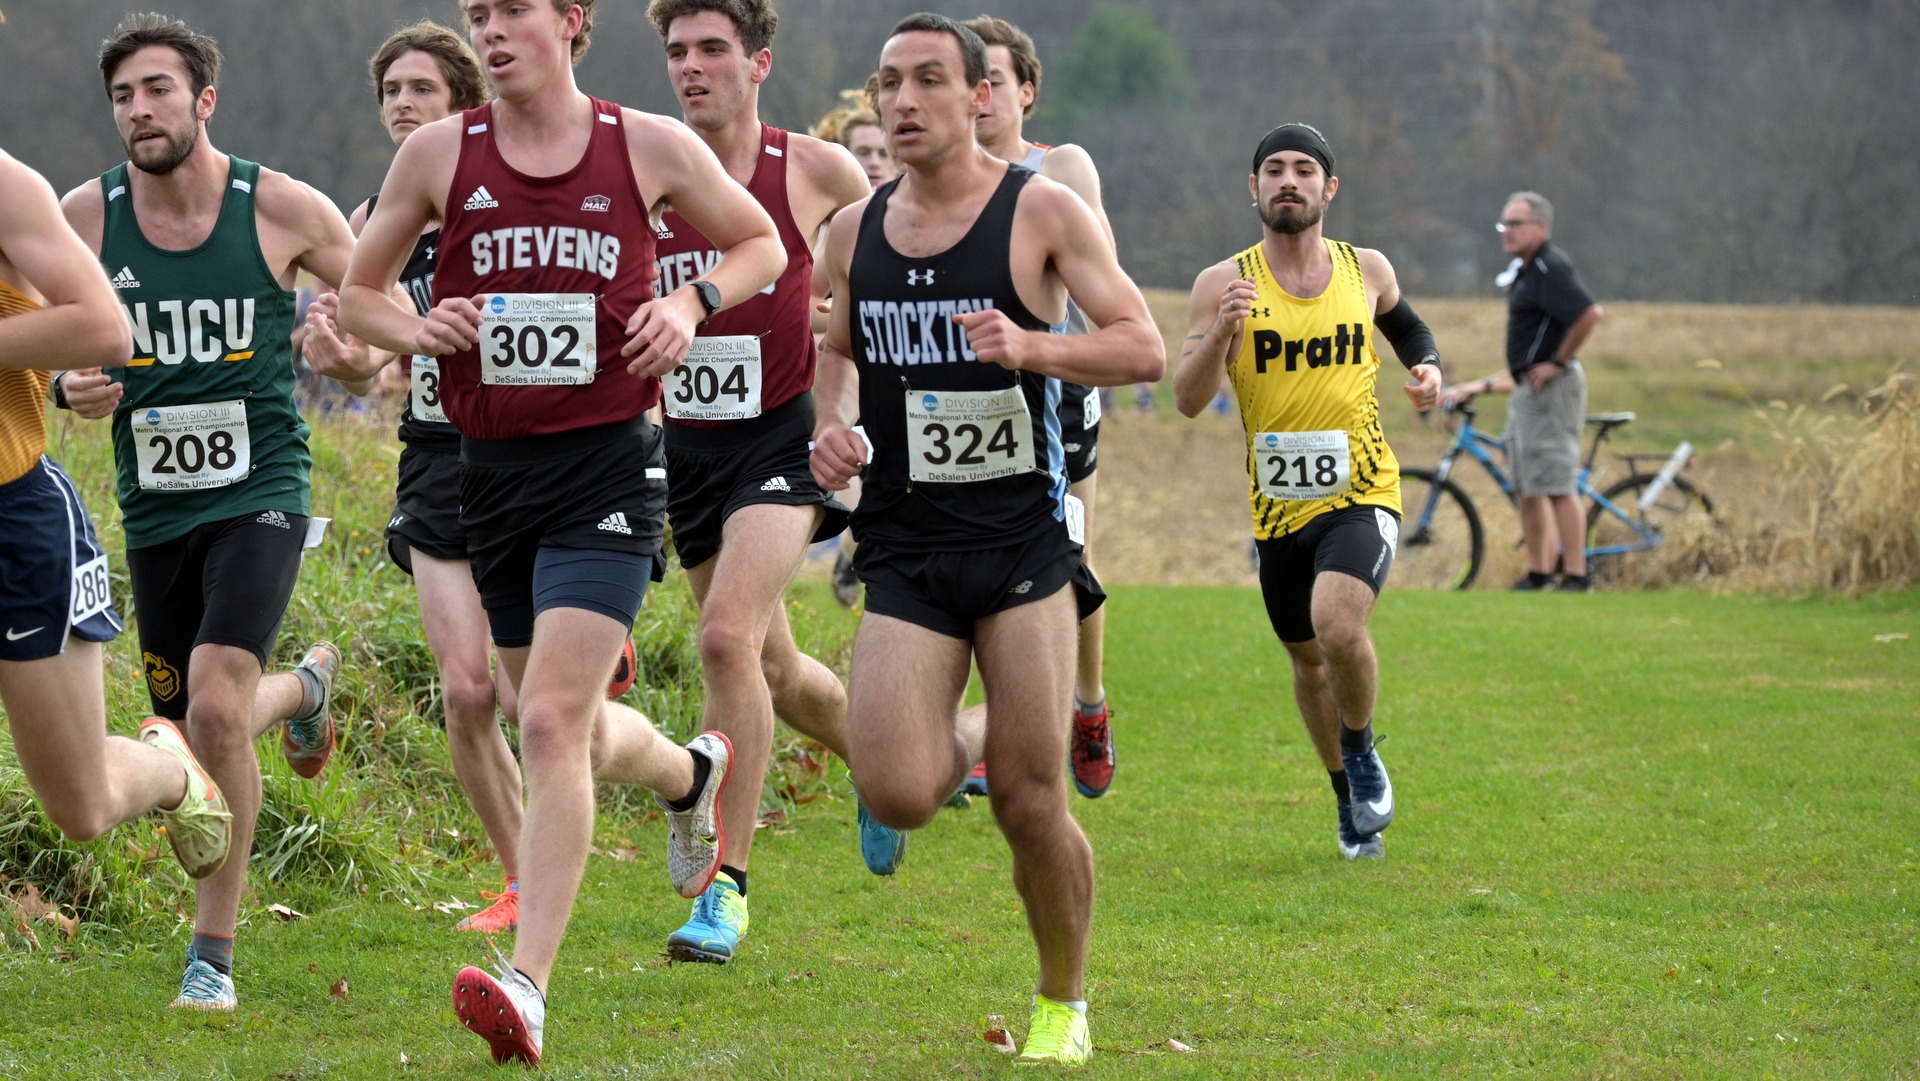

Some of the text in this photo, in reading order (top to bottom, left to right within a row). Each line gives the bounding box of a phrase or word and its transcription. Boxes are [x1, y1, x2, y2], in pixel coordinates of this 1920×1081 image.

[464, 200, 498, 210] adidas
[471, 226, 620, 280] STEVENS
[512, 300, 578, 310] DIVISION III
[497, 316, 526, 324] Regional
[540, 315, 593, 324] Championship
[122, 298, 254, 365] NJCU
[491, 325, 580, 367] 302
[737, 342, 745, 350] III
[1253, 323, 1365, 373] Pratt
[711, 356, 758, 364] Championship
[495, 375, 578, 385] DeSales University
[674, 364, 749, 404] 304
[945, 396, 1013, 408] DIVISION III
[167, 409, 217, 421] DIVISION
[221, 408, 230, 416] III
[677, 410, 745, 419] DeSales University
[929, 414, 960, 422] Regional
[154, 426, 182, 434] Regional
[196, 421, 244, 430] Championship
[922, 419, 1018, 465] 324
[1284, 436, 1325, 444] DIVISION
[149, 431, 236, 474] 208
[928, 467, 1017, 481] DeSales University
[1267, 455, 1338, 487] 218
[156, 477, 234, 489] DeSales University
[760, 484, 791, 492] adidas
[256, 516, 290, 529] adidas
[598, 523, 631, 534] adidas
[74, 564, 106, 617] 286
